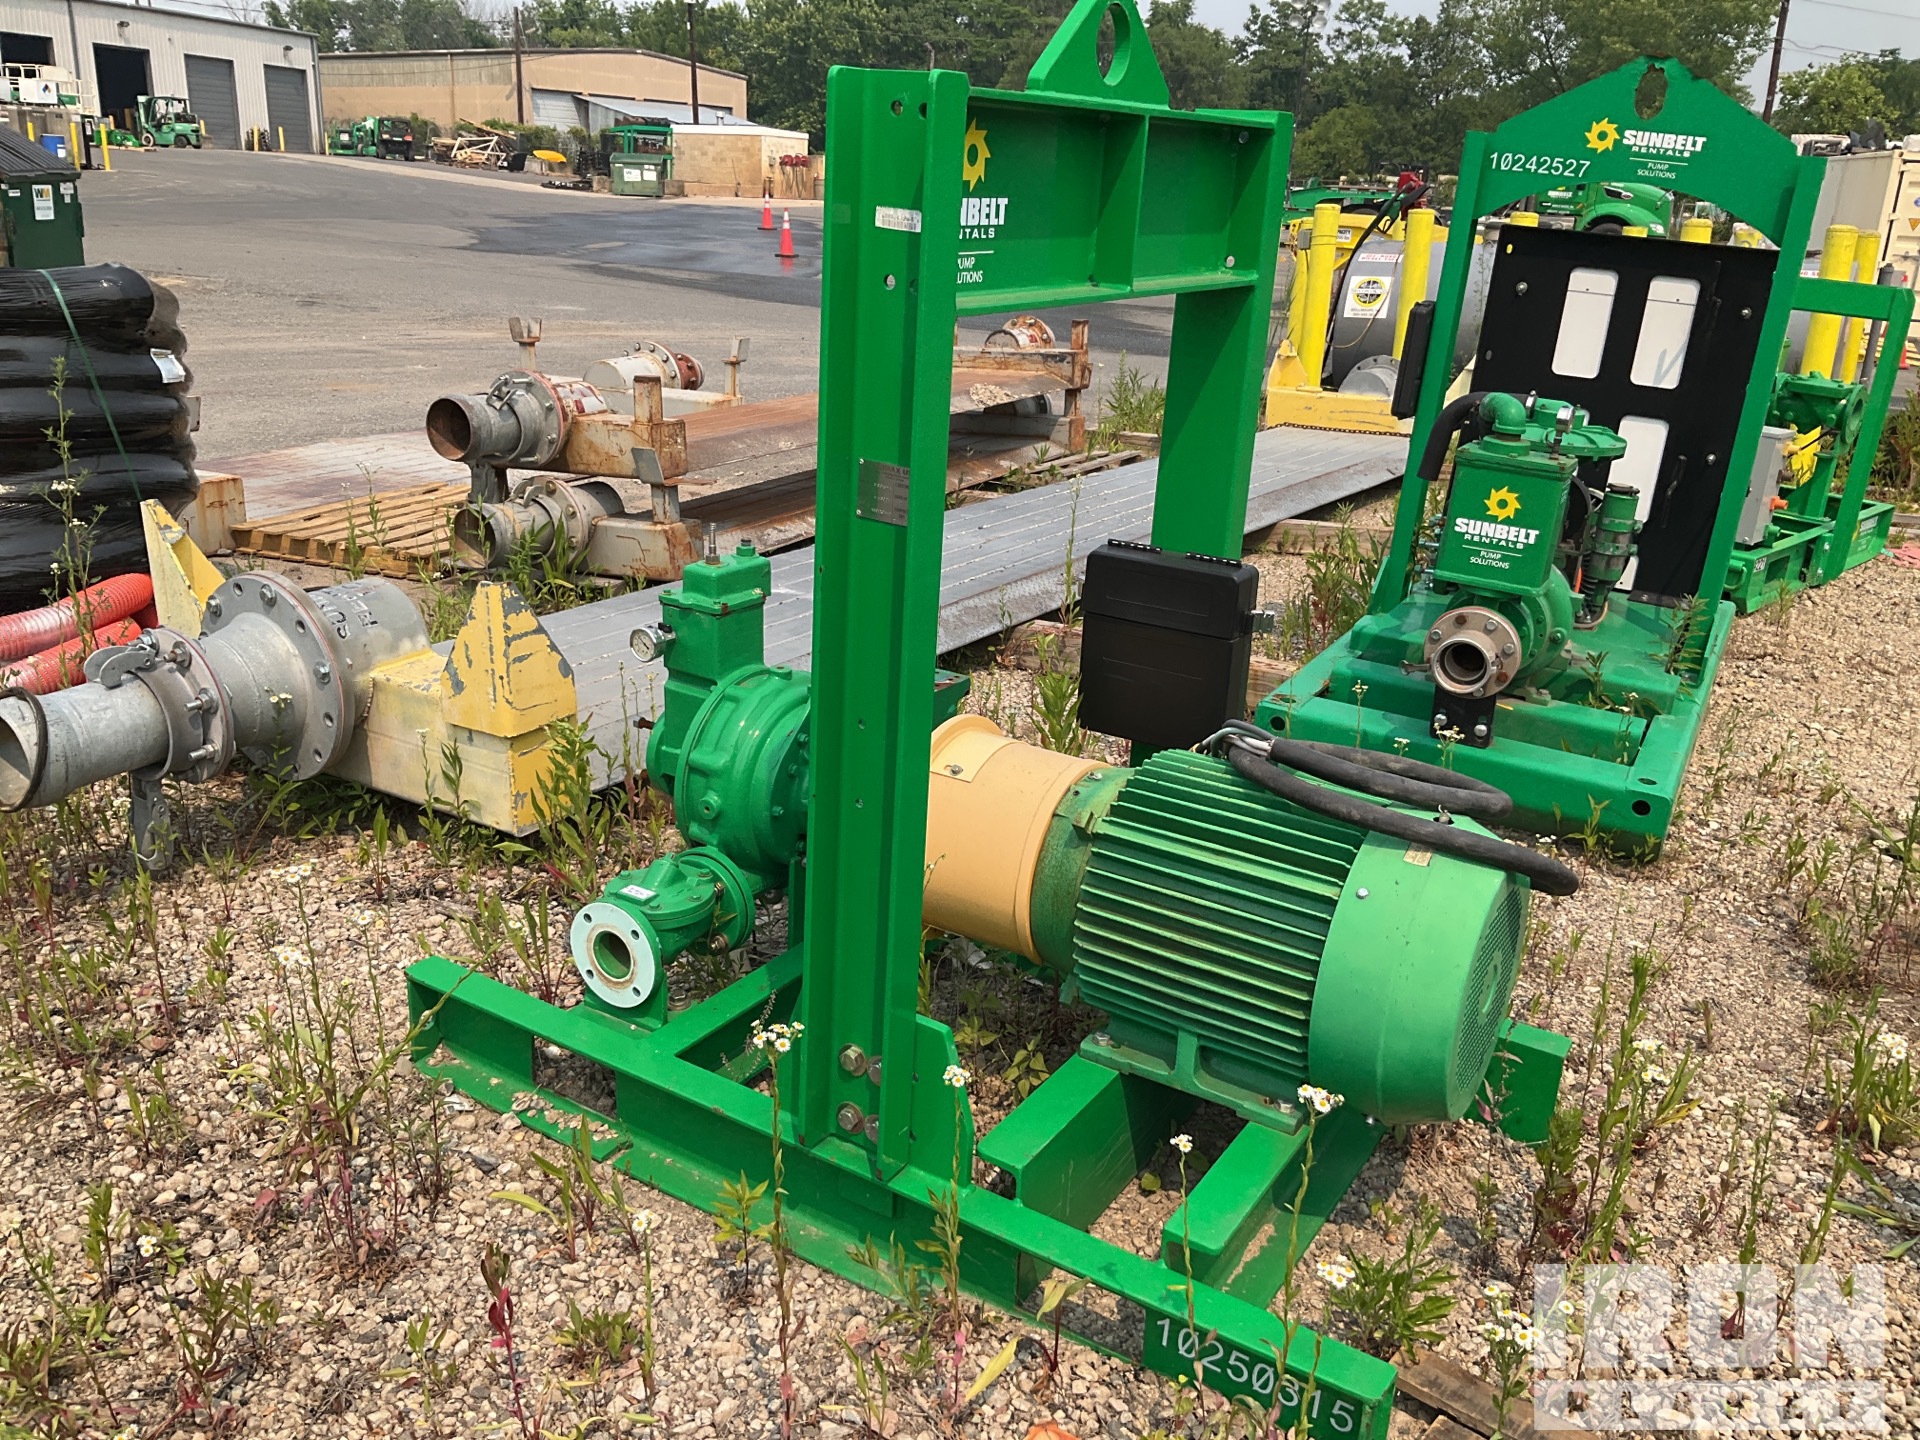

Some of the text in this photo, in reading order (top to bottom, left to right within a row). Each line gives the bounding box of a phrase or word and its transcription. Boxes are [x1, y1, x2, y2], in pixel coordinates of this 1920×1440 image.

[1623, 129, 1707, 152] SUNBELT
[1631, 146, 1691, 158] RENTALS
[1489, 152, 1591, 178] 10242527
[1637, 168, 1676, 179] SOLUTIONS
[957, 270, 984, 284] UTIONS
[1454, 517, 1540, 545] SUNBELT
[1463, 533, 1524, 550] RENTALS
[1479, 550, 1502, 560] PUMP
[1469, 556, 1510, 570] SOLUTIONS
[1156, 1317, 1355, 1434] 10250315
